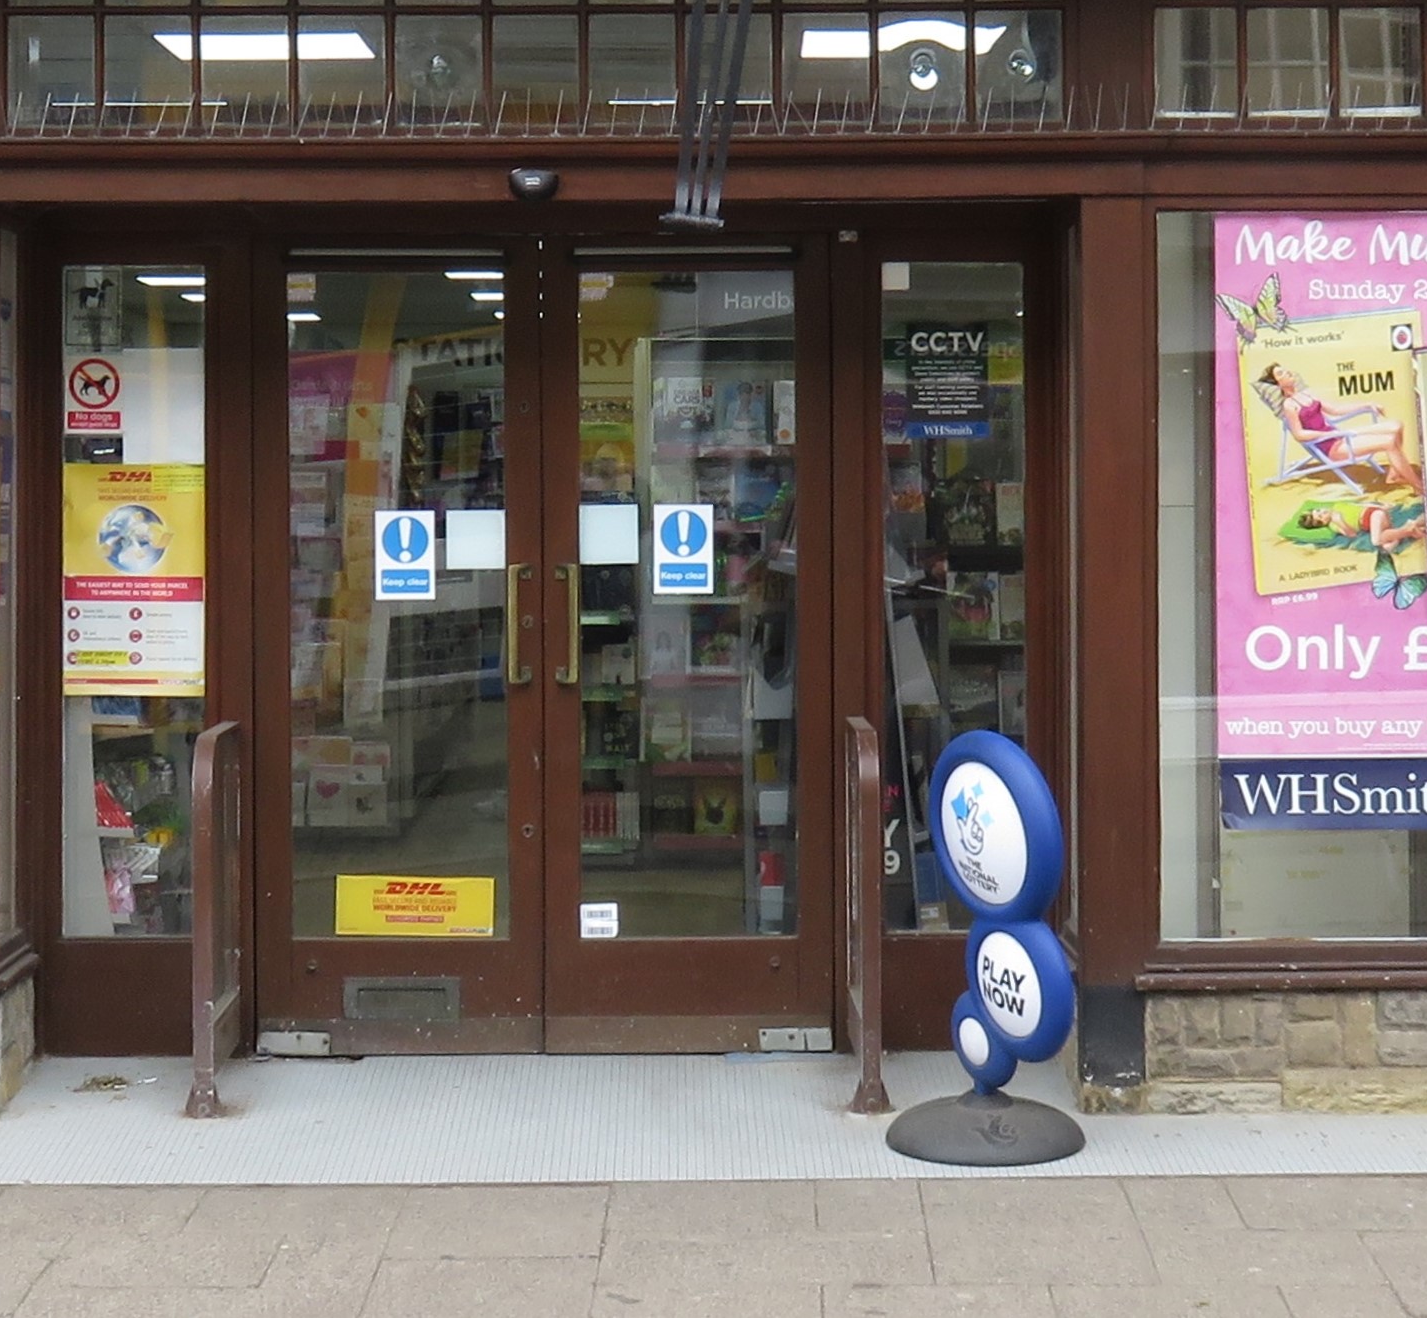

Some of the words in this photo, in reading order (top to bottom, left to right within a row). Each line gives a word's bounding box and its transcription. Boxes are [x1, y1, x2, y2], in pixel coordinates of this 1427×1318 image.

[1235, 220, 1356, 265] Make
[723, 290, 794, 310] Hardb
[1307, 279, 1406, 302] Sunday
[910, 331, 985, 353] CCTV
[1294, 336, 1304, 346] it
[1336, 361, 1356, 372] THE
[1338, 370, 1396, 397] MUM
[75, 412, 88, 420] No
[90, 412, 113, 422] dogs
[923, 425, 973, 436] WHSmith
[382, 577, 407, 588] Keep
[408, 577, 429, 587] clear
[661, 571, 684, 582] Keep
[685, 571, 706, 581] clear
[1279, 574, 1286, 582] A
[1288, 567, 1331, 581] LADYBIRD
[1333, 563, 1358, 574] BOOK
[1244, 623, 1381, 680] Only
[1225, 716, 1285, 736] when
[1287, 718, 1331, 739] you
[1334, 715, 1376, 738] buy
[1380, 718, 1423, 738] any
[958, 860, 999, 887] NATIONAL
[966, 856, 983, 872] THE
[385, 881, 446, 896] DHL
[963, 871, 1000, 895] LOTTERY
[373, 904, 419, 912] WORLDWIDE
[421, 905, 457, 913] DELIVERY
[983, 955, 1026, 994] PLAY
[983, 978, 1025, 1017] NOW
